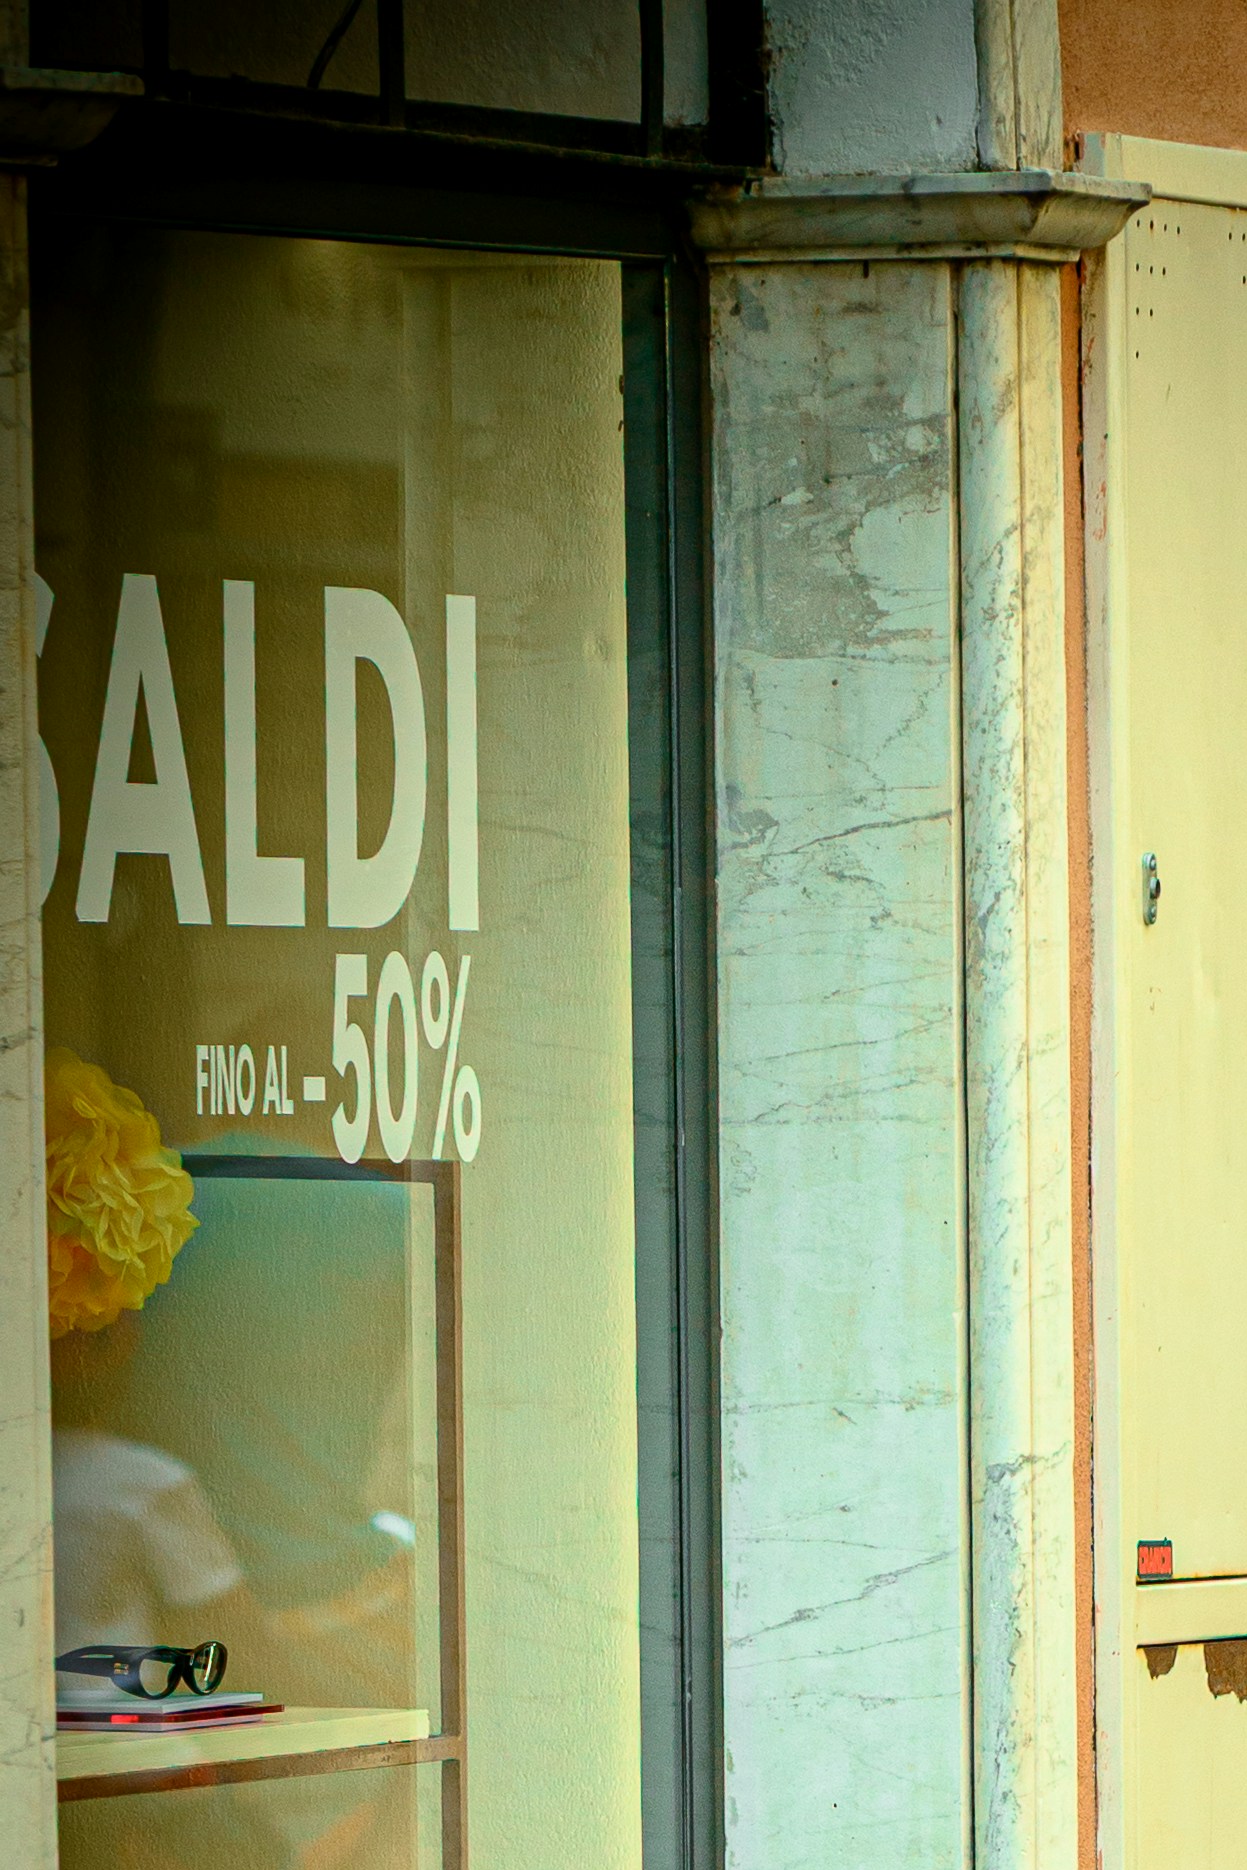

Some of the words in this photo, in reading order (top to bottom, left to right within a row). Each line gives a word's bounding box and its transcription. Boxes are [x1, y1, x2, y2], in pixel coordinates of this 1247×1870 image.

[195, 1043, 257, 1116] FINO
[262, 1044, 295, 1116] AL
[302, 950, 482, 1165] -50%
